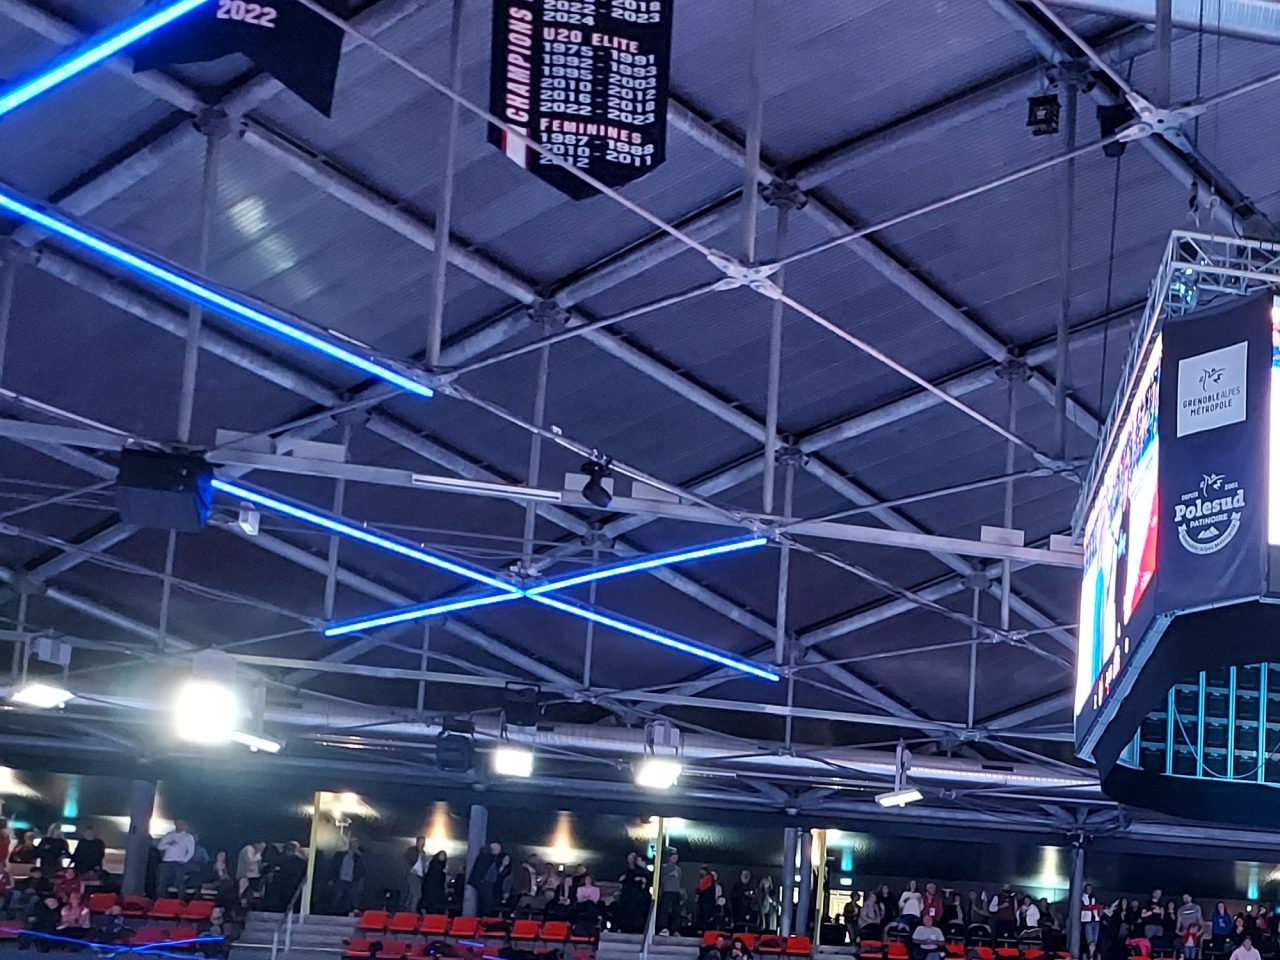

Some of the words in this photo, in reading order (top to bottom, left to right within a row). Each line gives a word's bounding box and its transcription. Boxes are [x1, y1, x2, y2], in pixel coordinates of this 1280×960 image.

[216, 0, 277, 28] 2022
[543, 0, 596, 14] 2022
[611, 8, 660, 23] 2023
[543, 11, 595, 26] 2024
[543, 27, 583, 43] U20
[591, 33, 639, 53] ELITE
[542, 42, 594, 56] 1975
[506, 7, 533, 122] CHAMPIONS
[542, 54, 593, 69] 1992
[541, 66, 593, 80] 1995
[540, 78, 592, 91] 2010
[540, 90, 591, 104] 2016
[539, 101, 592, 116] 2022
[540, 118, 642, 144] FEMININES
[539, 132, 590, 146] 1987
[605, 150, 652, 167] 2011
[1174, 489, 1245, 522] Polesud
[1190, 513, 1228, 528] PATINOIRE
